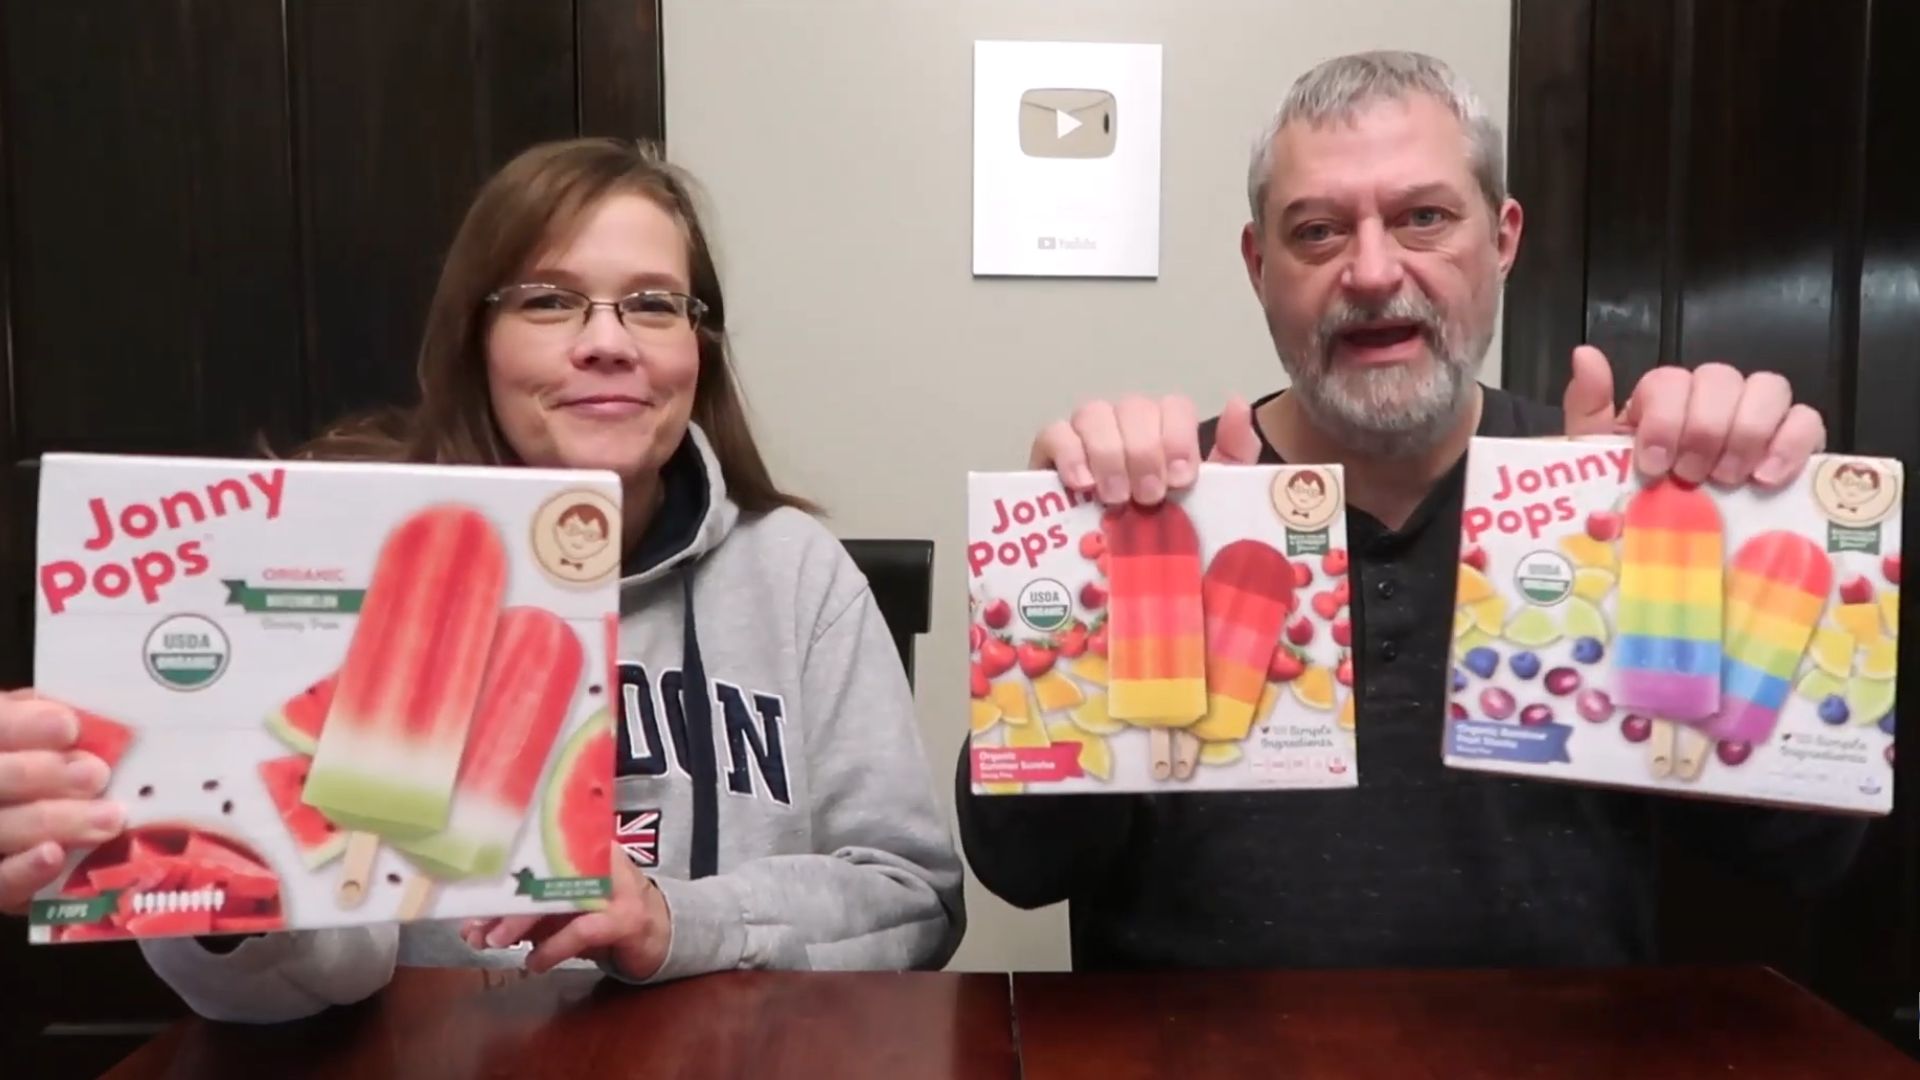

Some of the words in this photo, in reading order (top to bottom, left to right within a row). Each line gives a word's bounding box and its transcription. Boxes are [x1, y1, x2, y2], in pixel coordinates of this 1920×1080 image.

[1492, 448, 1633, 501] Jonny
[84, 468, 286, 550] Jonny
[1463, 497, 1576, 543] Pops
[40, 535, 209, 614] Pops
[968, 524, 1068, 578] Pops
[1029, 591, 1060, 603] USDA
[163, 633, 210, 649] USDA
